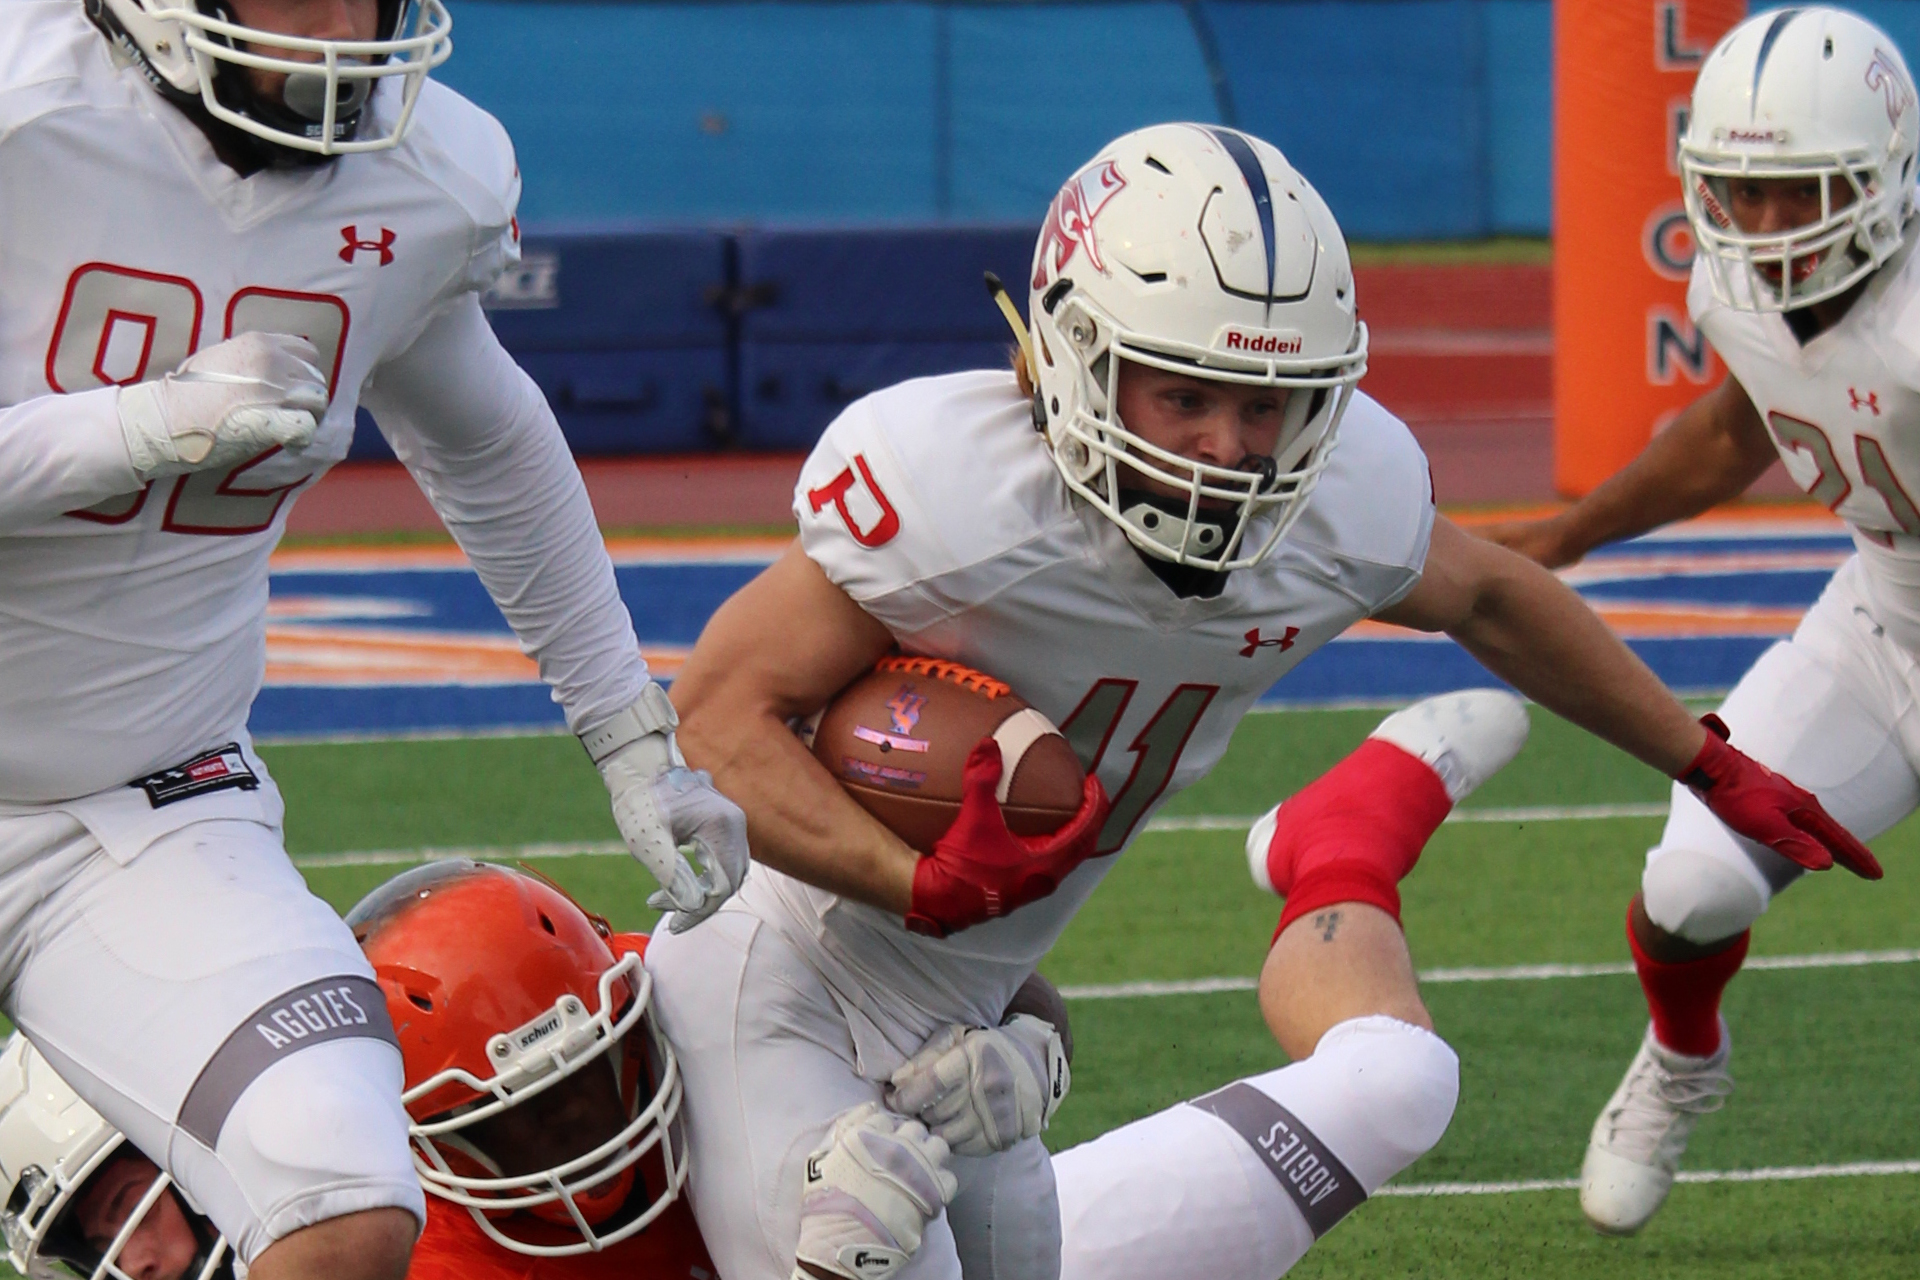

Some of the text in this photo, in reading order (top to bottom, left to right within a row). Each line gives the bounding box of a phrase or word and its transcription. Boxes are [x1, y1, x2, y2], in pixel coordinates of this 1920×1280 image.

[1226, 331, 1303, 355] Riddell
[255, 986, 370, 1050] AGGIES
[520, 1016, 559, 1048] schutt
[1257, 1120, 1341, 1207] AGGIES
